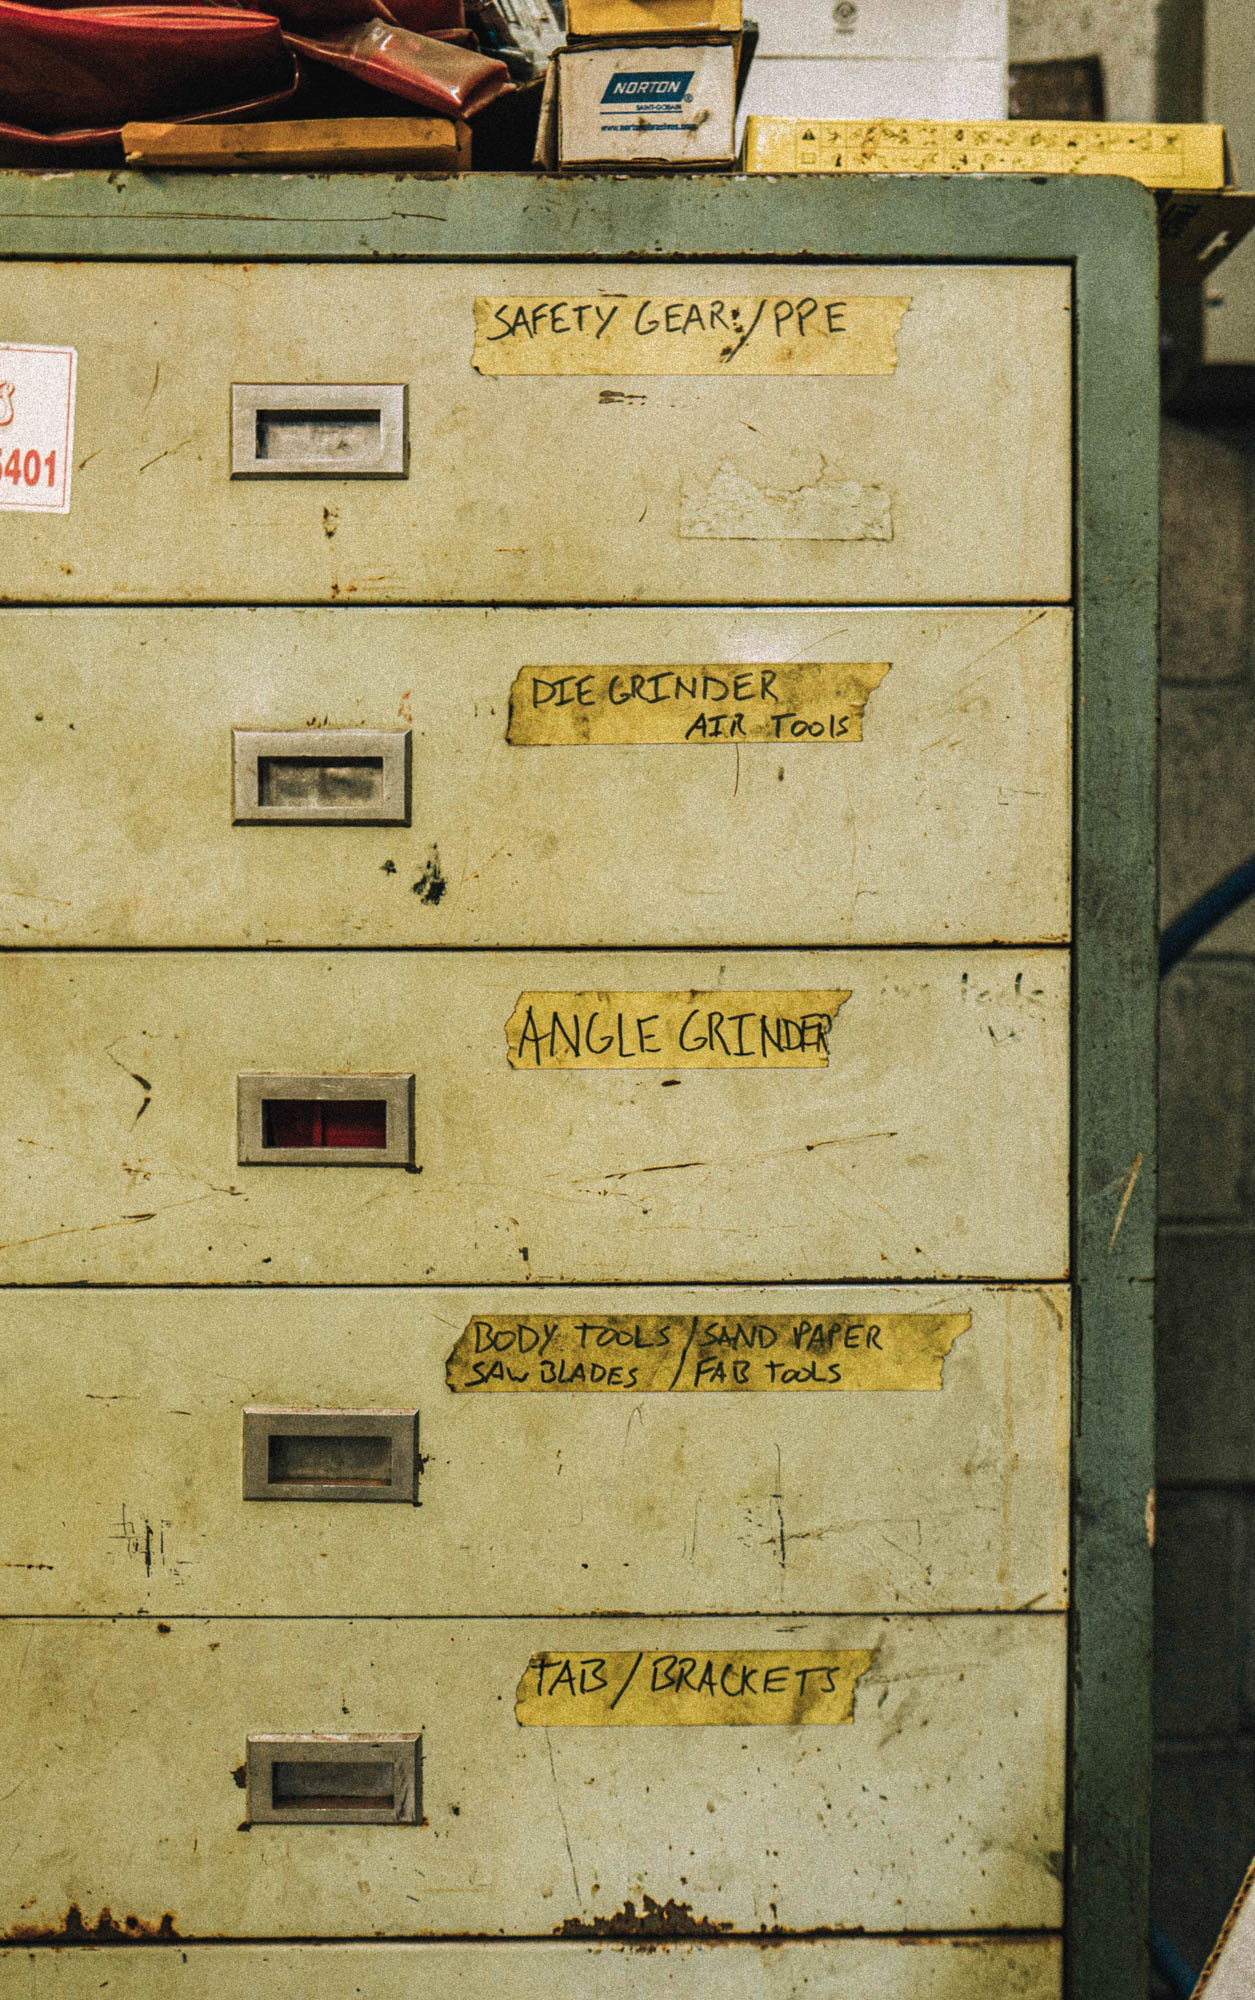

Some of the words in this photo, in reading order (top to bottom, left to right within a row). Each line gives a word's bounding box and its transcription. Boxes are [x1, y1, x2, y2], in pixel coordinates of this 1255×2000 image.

[612, 81, 682, 95] NORTON
[488, 302, 618, 340] SAFETY
[774, 298, 848, 338] PPE
[0, 448, 56, 487] 401
[533, 675, 596, 708] DIE
[608, 669, 779, 704] GRINDER
[685, 713, 746, 740] AIR
[518, 1005, 663, 1066] ANGLE
[679, 1009, 833, 1058] GRINDER
[474, 1321, 558, 1356] BODY
[700, 1322, 778, 1349] SAND
[792, 1321, 883, 1350] PAPER
[540, 1359, 639, 1389] BLADES
[693, 1356, 751, 1388] FAB
[530, 1658, 609, 1696] TAB
[651, 1655, 841, 1697] BRACKETS
